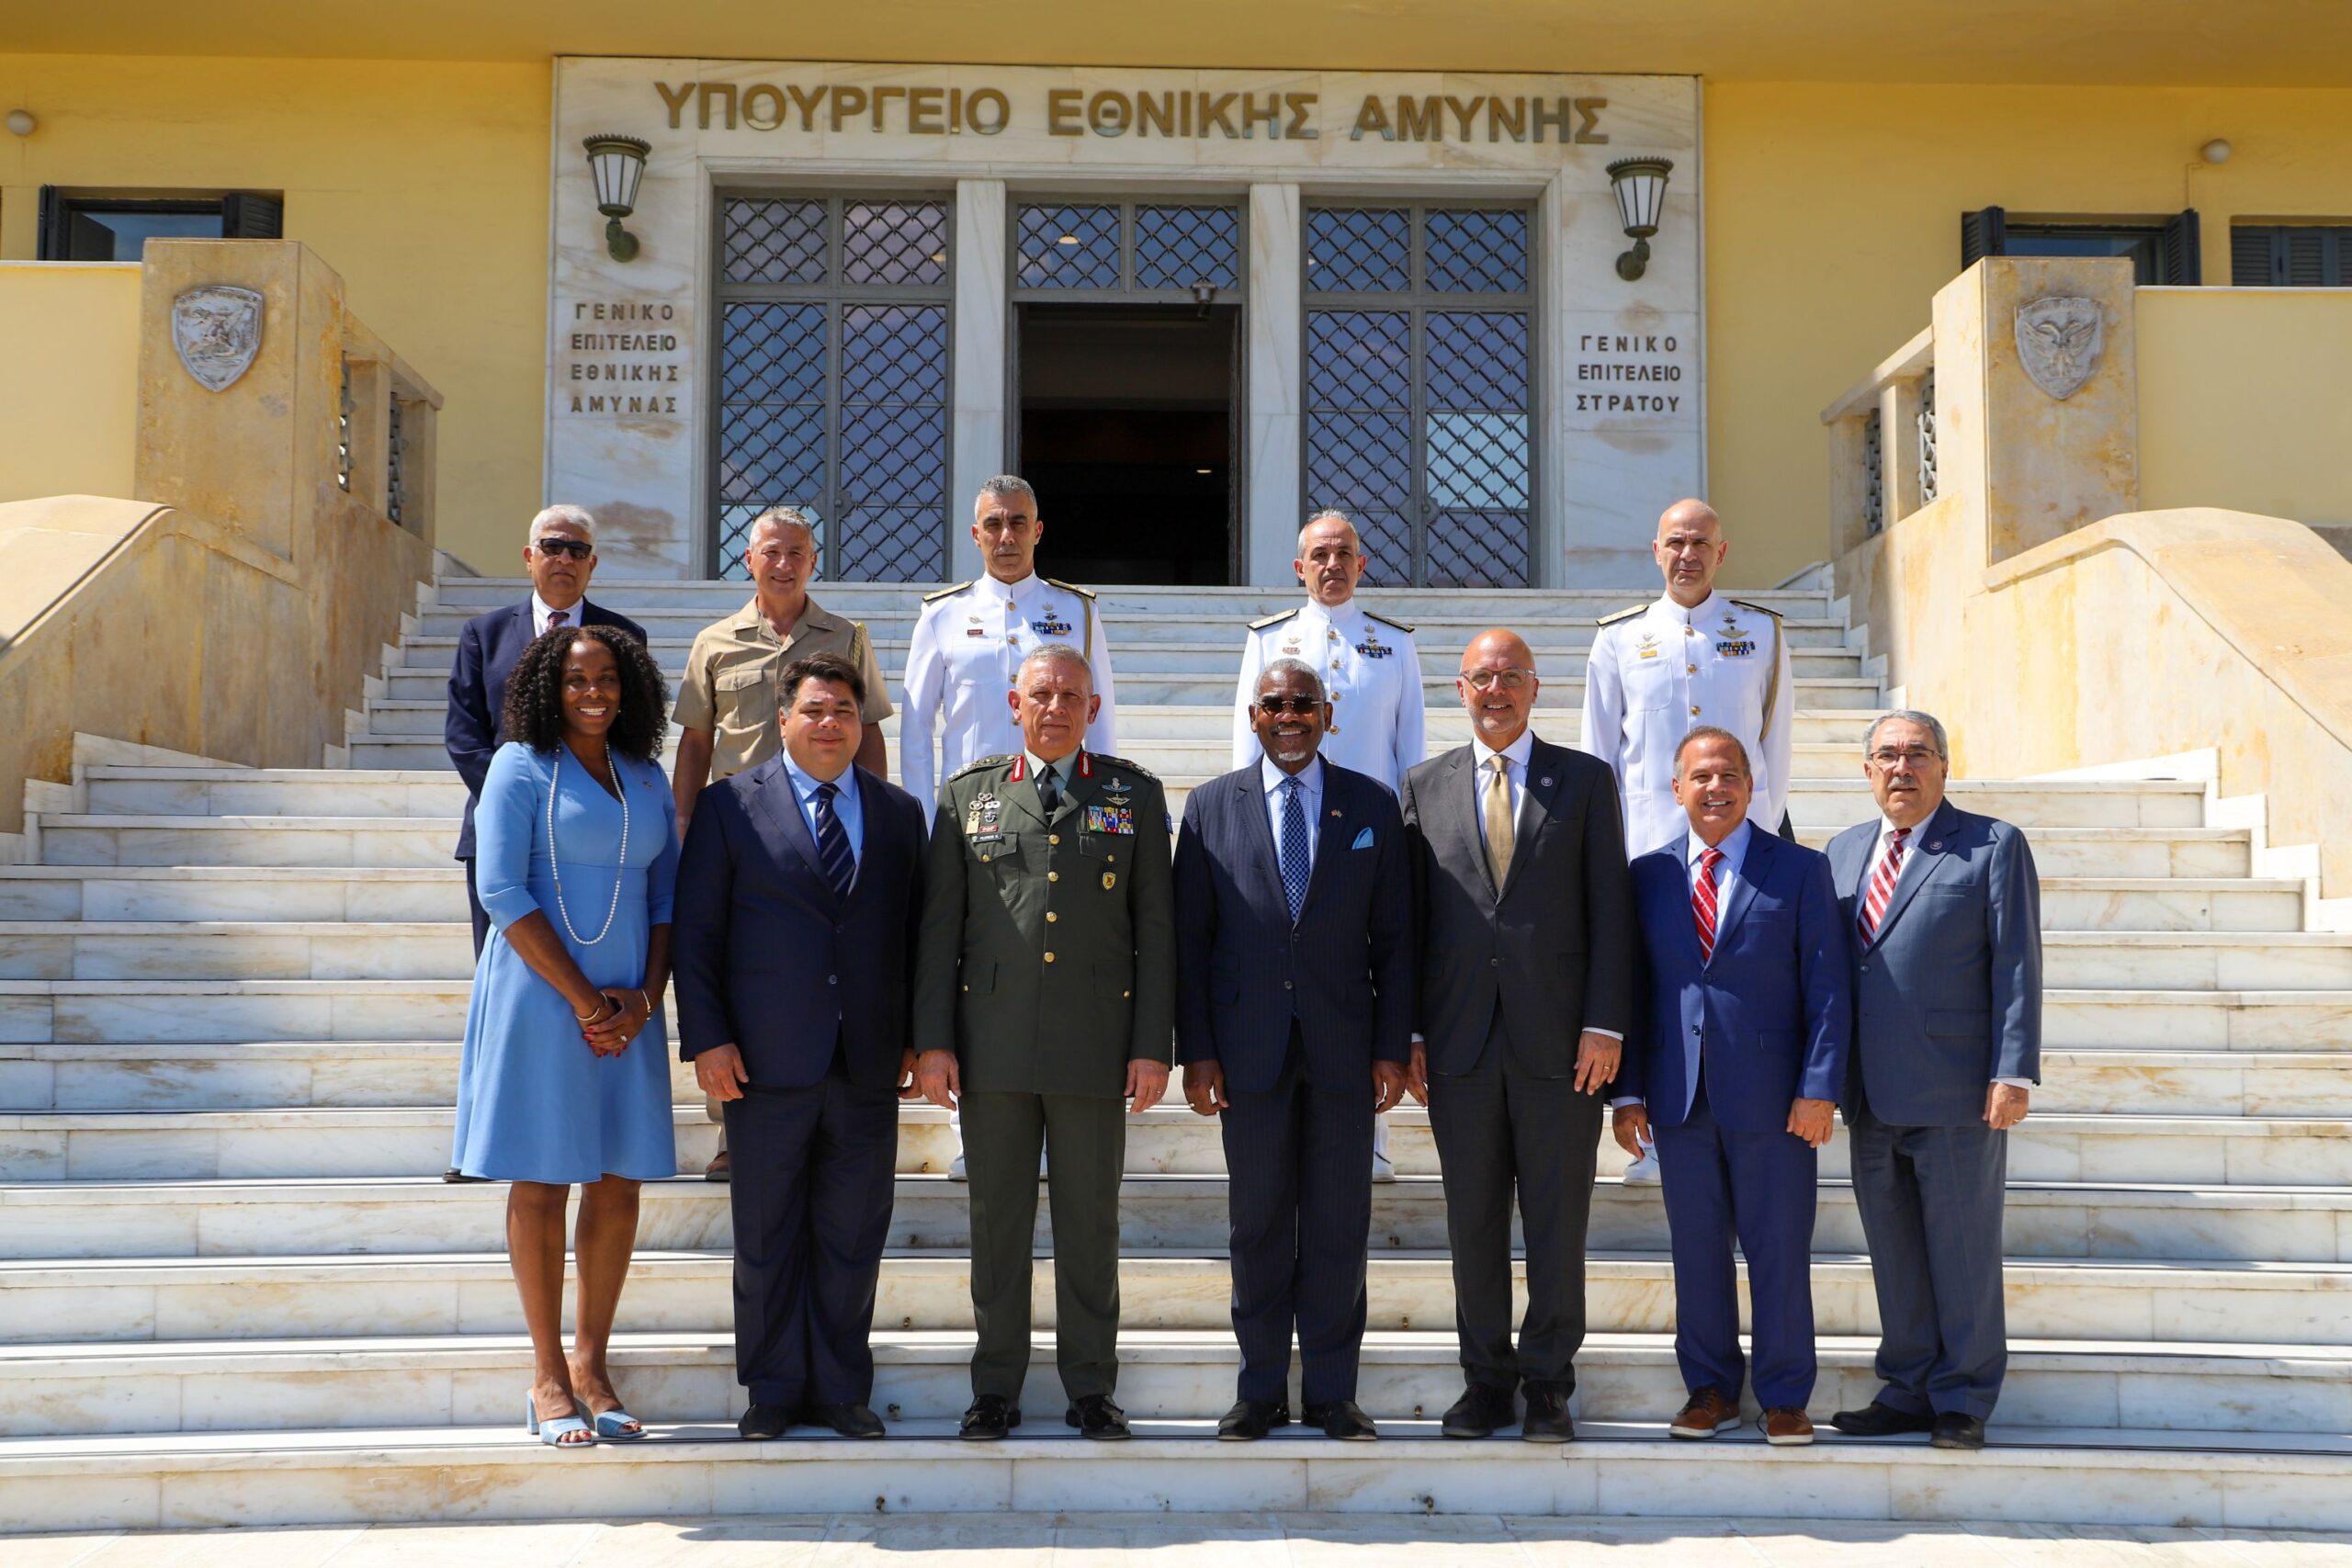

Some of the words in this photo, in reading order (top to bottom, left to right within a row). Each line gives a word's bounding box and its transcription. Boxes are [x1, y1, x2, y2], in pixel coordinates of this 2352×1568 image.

[653, 81, 1012, 136] ΥΠΟΥΡΓΕΙΟ
[1047, 88, 1319, 140] ΕΘΝΙΚΗΣ
[1350, 95, 1610, 145] ΑΜΥΝΗΣ
[575, 303, 674, 321] ΓΕΝΙΚΟ
[571, 333, 677, 351] ΕΠΙΤΕΛΕΙΟ
[1580, 334, 1678, 353] ΓΕΝΙΚΟ
[571, 364, 678, 382] ΕΘΝΙΚΗΣ
[1577, 364, 1682, 382] ΕΠΙΤΕΛΕΙΟ
[570, 396, 677, 413] ΑΜΥΝΑΣ
[1576, 394, 1679, 412] ΣΤΡΑΤΟΥ
